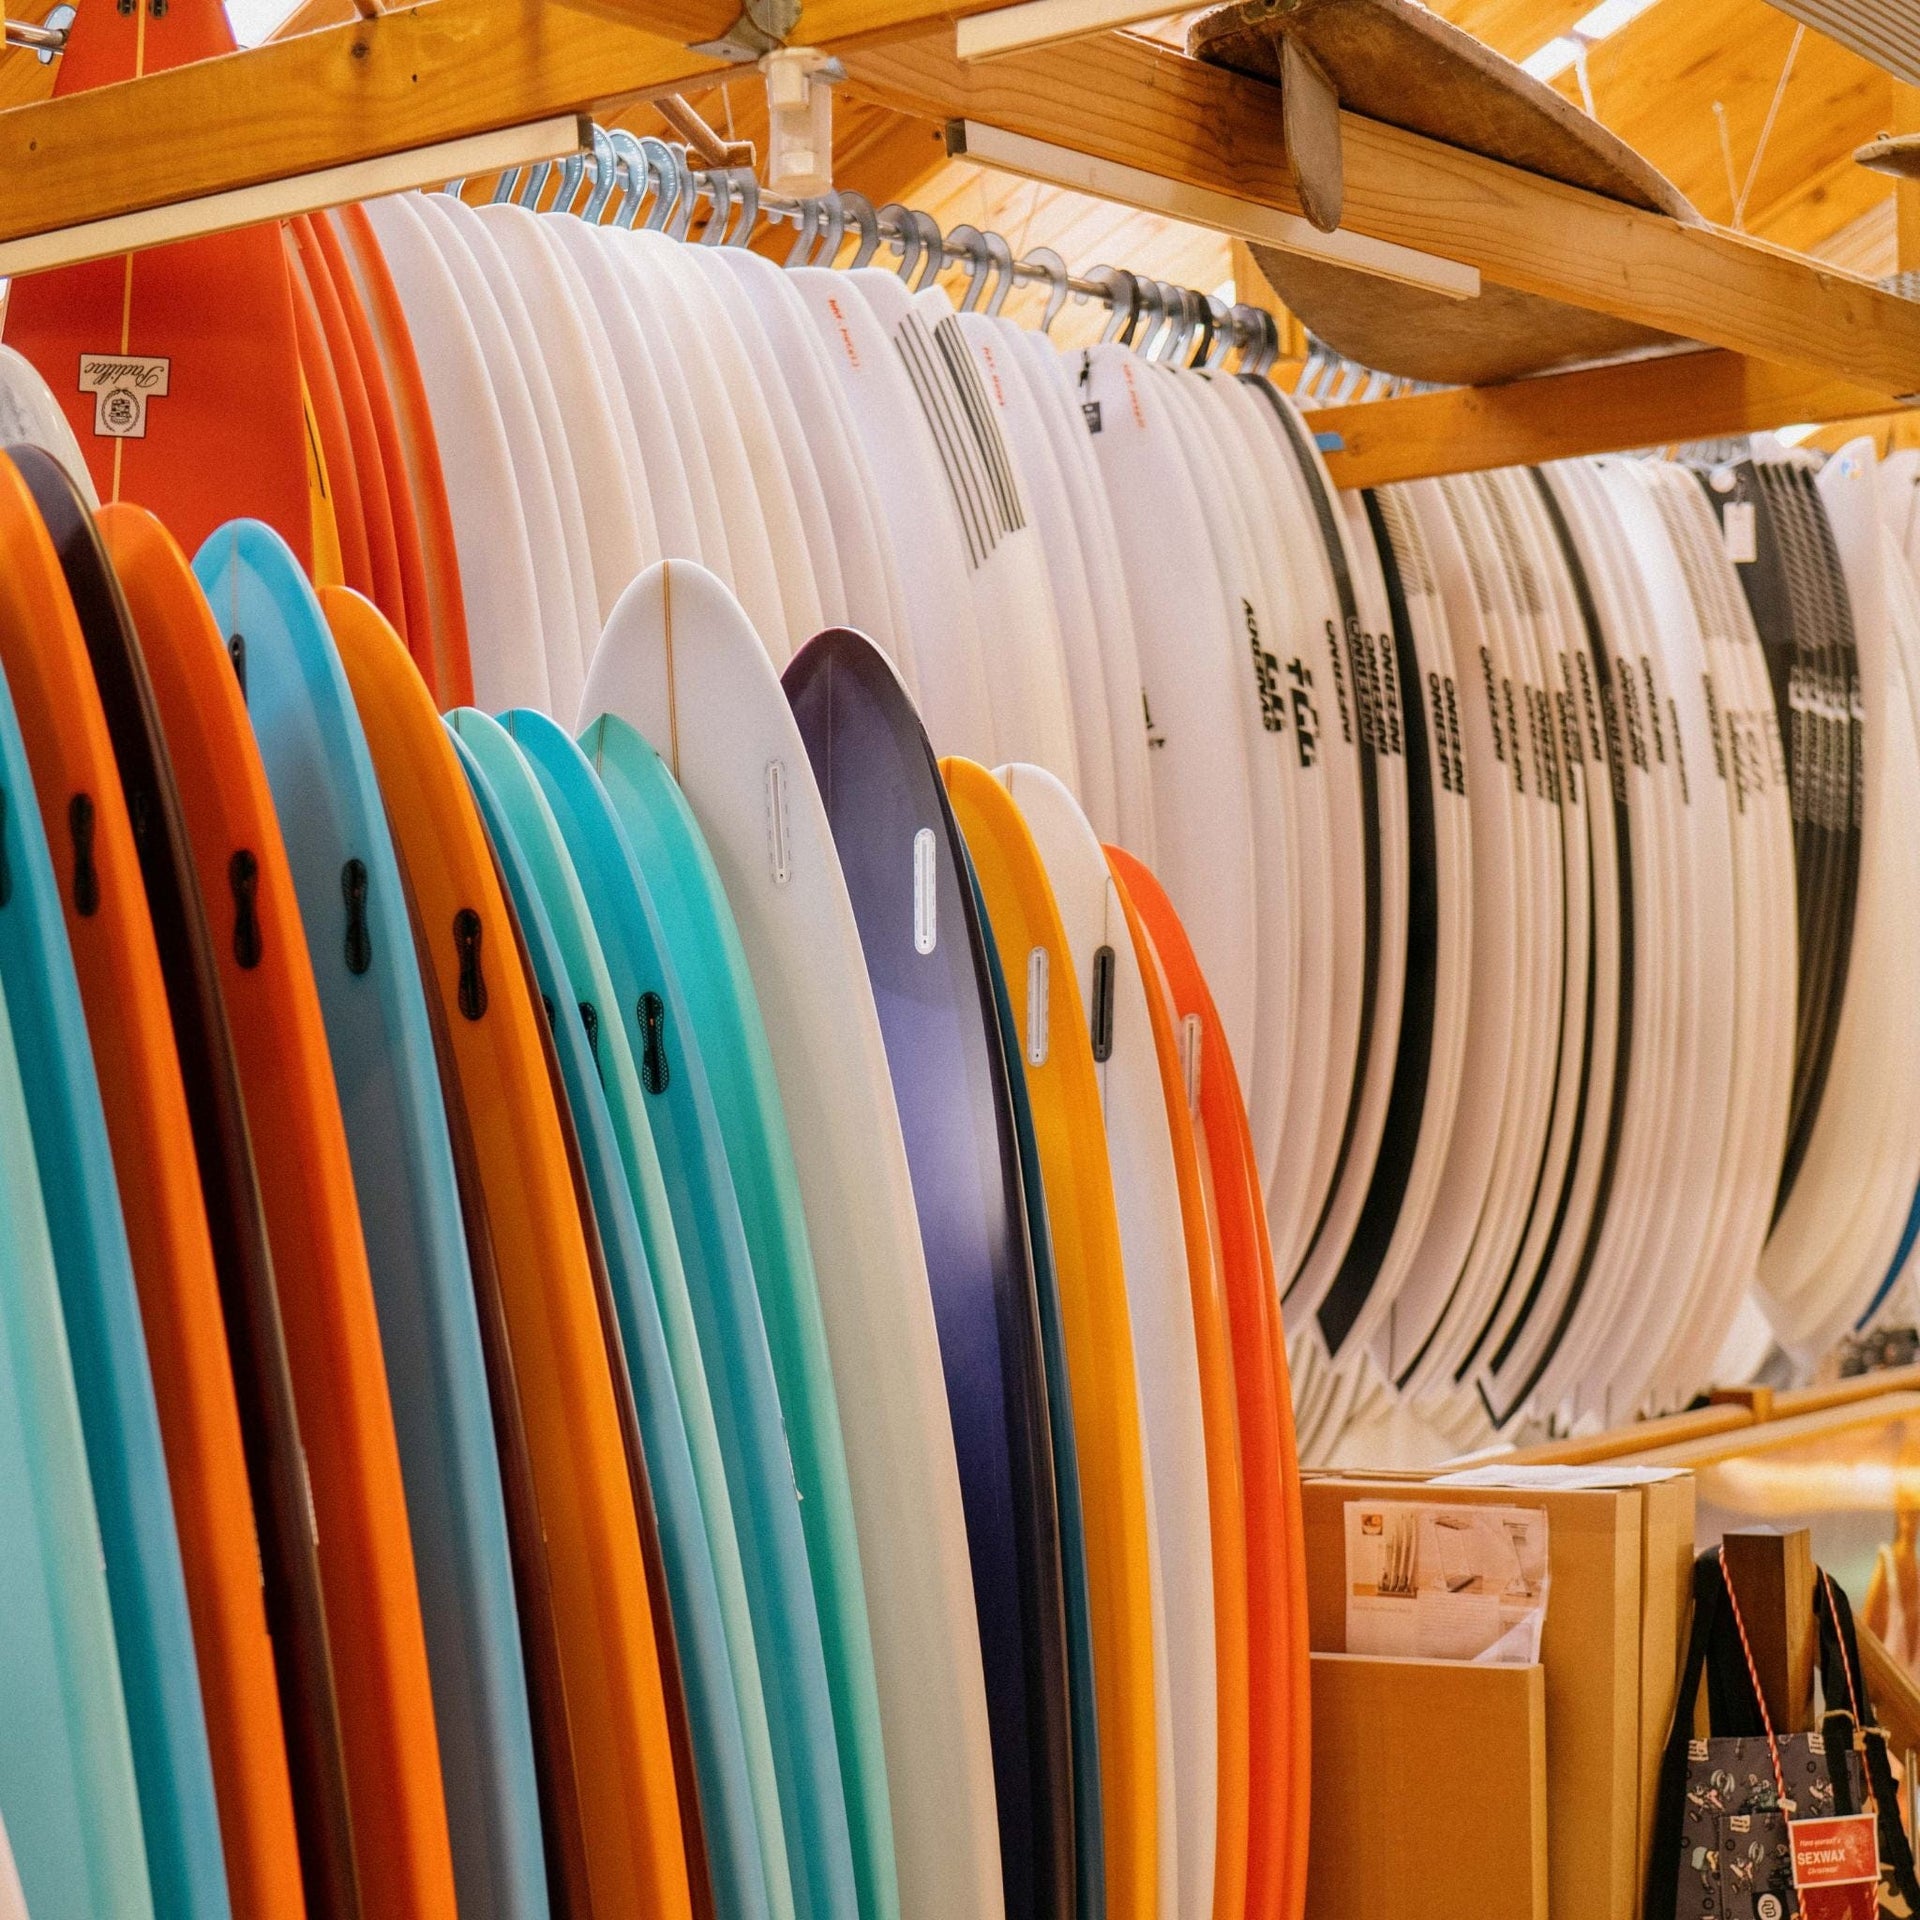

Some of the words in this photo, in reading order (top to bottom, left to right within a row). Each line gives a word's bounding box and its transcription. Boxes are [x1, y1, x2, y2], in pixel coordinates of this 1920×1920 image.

[84, 362, 164, 388] Padillac
[1380, 633, 1402, 755] INFERNO
[1430, 673, 1452, 791] INFERNO
[1797, 1849, 1846, 1866] SEXWAX
